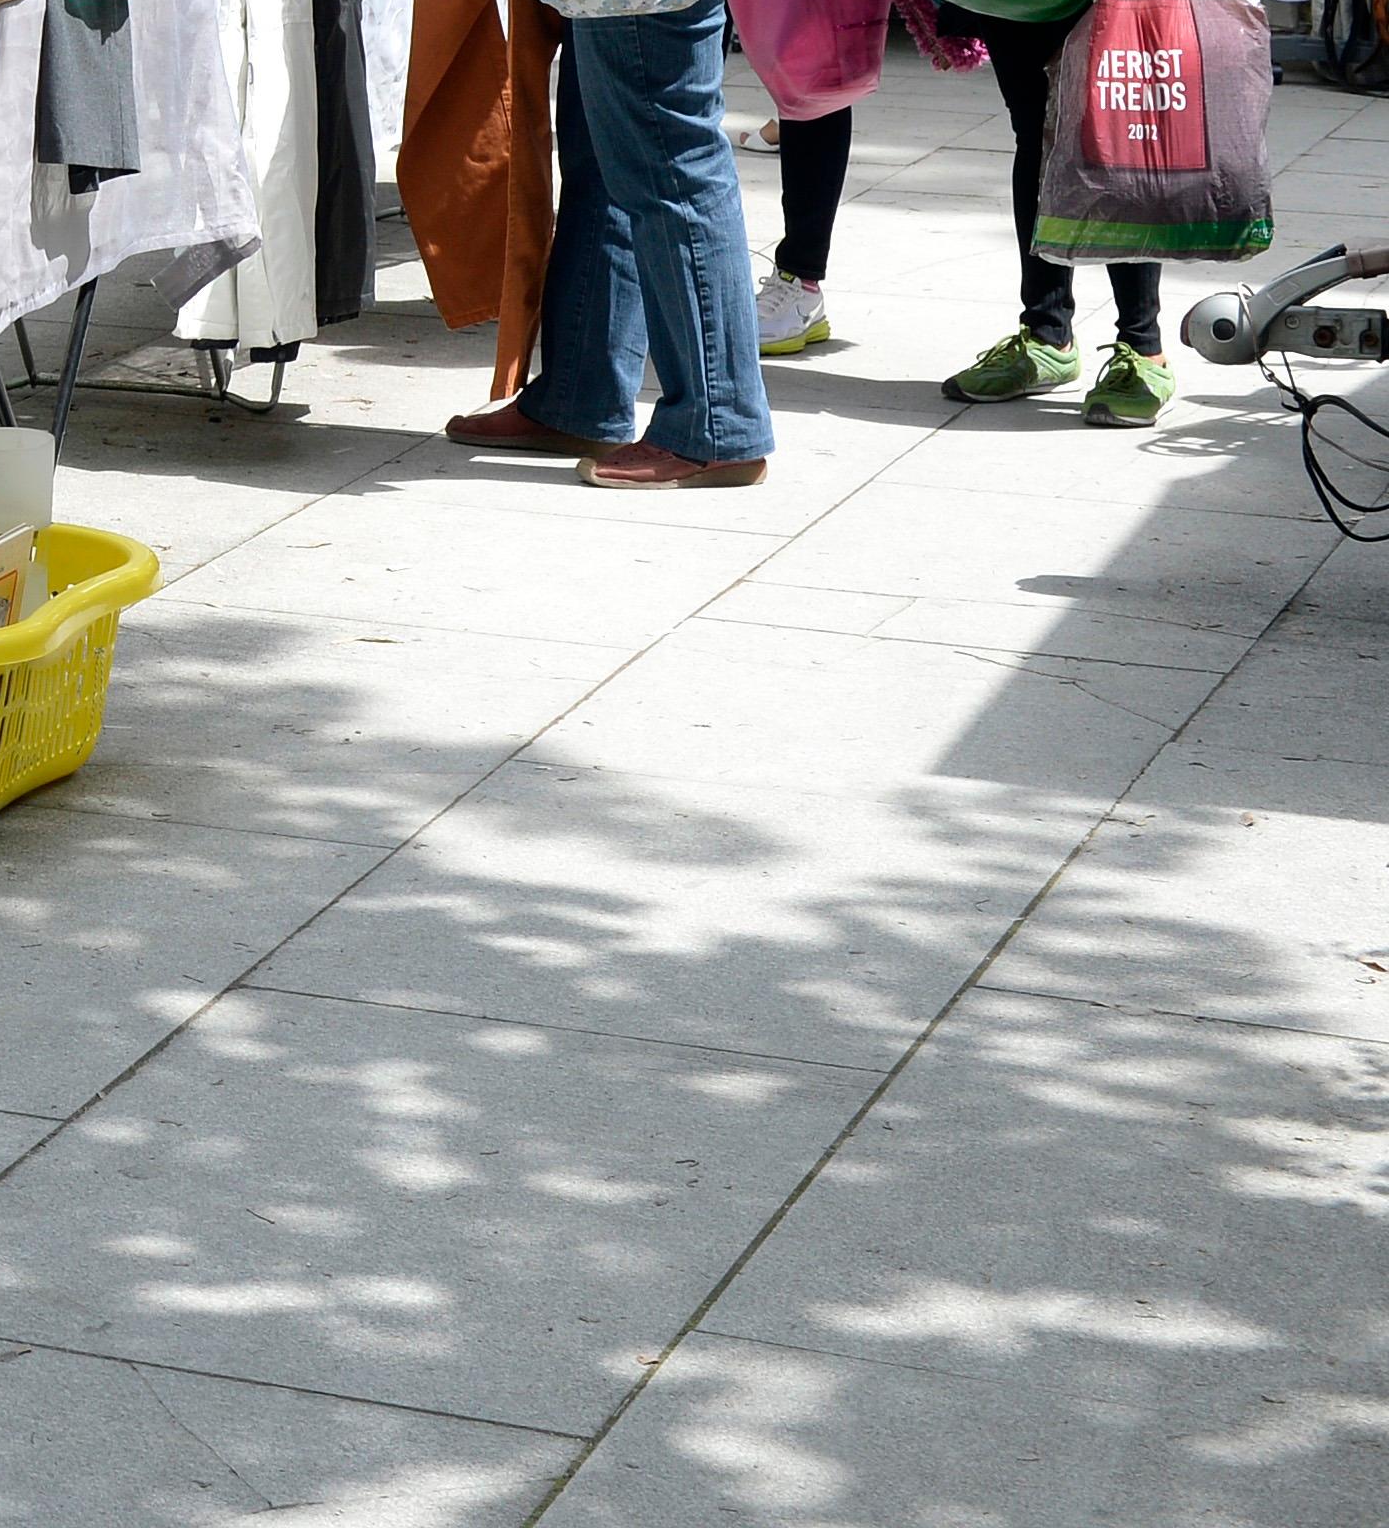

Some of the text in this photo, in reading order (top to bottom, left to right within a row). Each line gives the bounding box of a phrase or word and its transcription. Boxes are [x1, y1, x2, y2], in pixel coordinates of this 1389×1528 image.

[1097, 48, 1184, 80] HERBST
[1096, 80, 1188, 112] TRENDS
[1127, 123, 1158, 141] 2012
